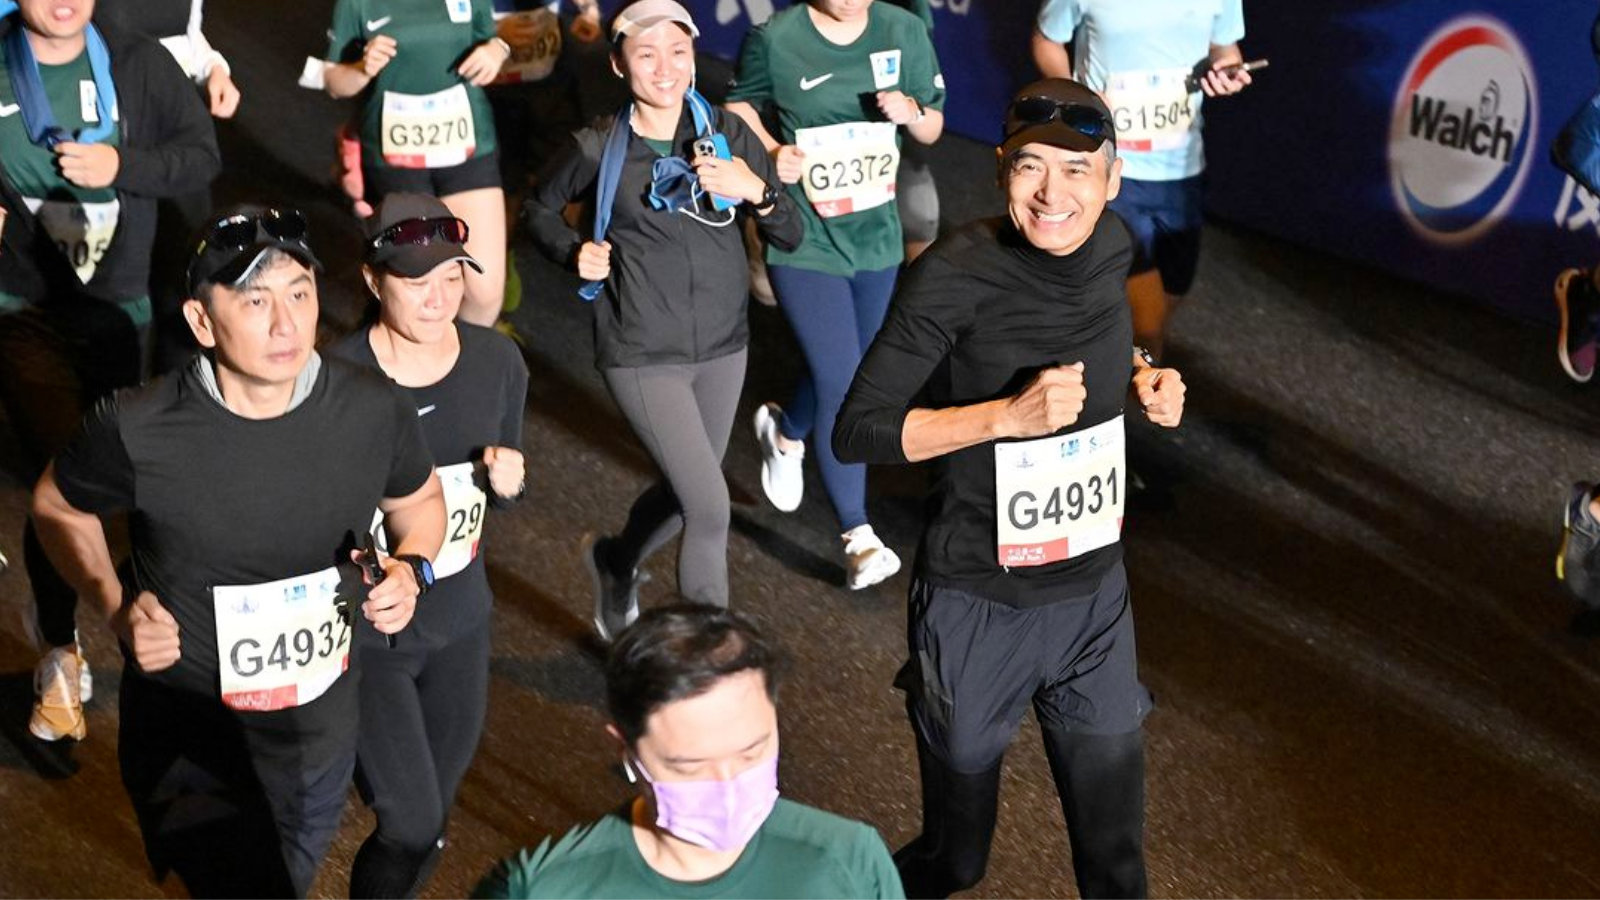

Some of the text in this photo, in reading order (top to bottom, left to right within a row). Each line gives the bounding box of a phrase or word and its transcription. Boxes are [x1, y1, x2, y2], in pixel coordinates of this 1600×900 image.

[389, 117, 468, 146] G3270
[1113, 97, 1191, 132] G1504
[1410, 94, 1515, 163] Walch
[809, 153, 893, 190] G2372
[1008, 467, 1117, 530] G4931
